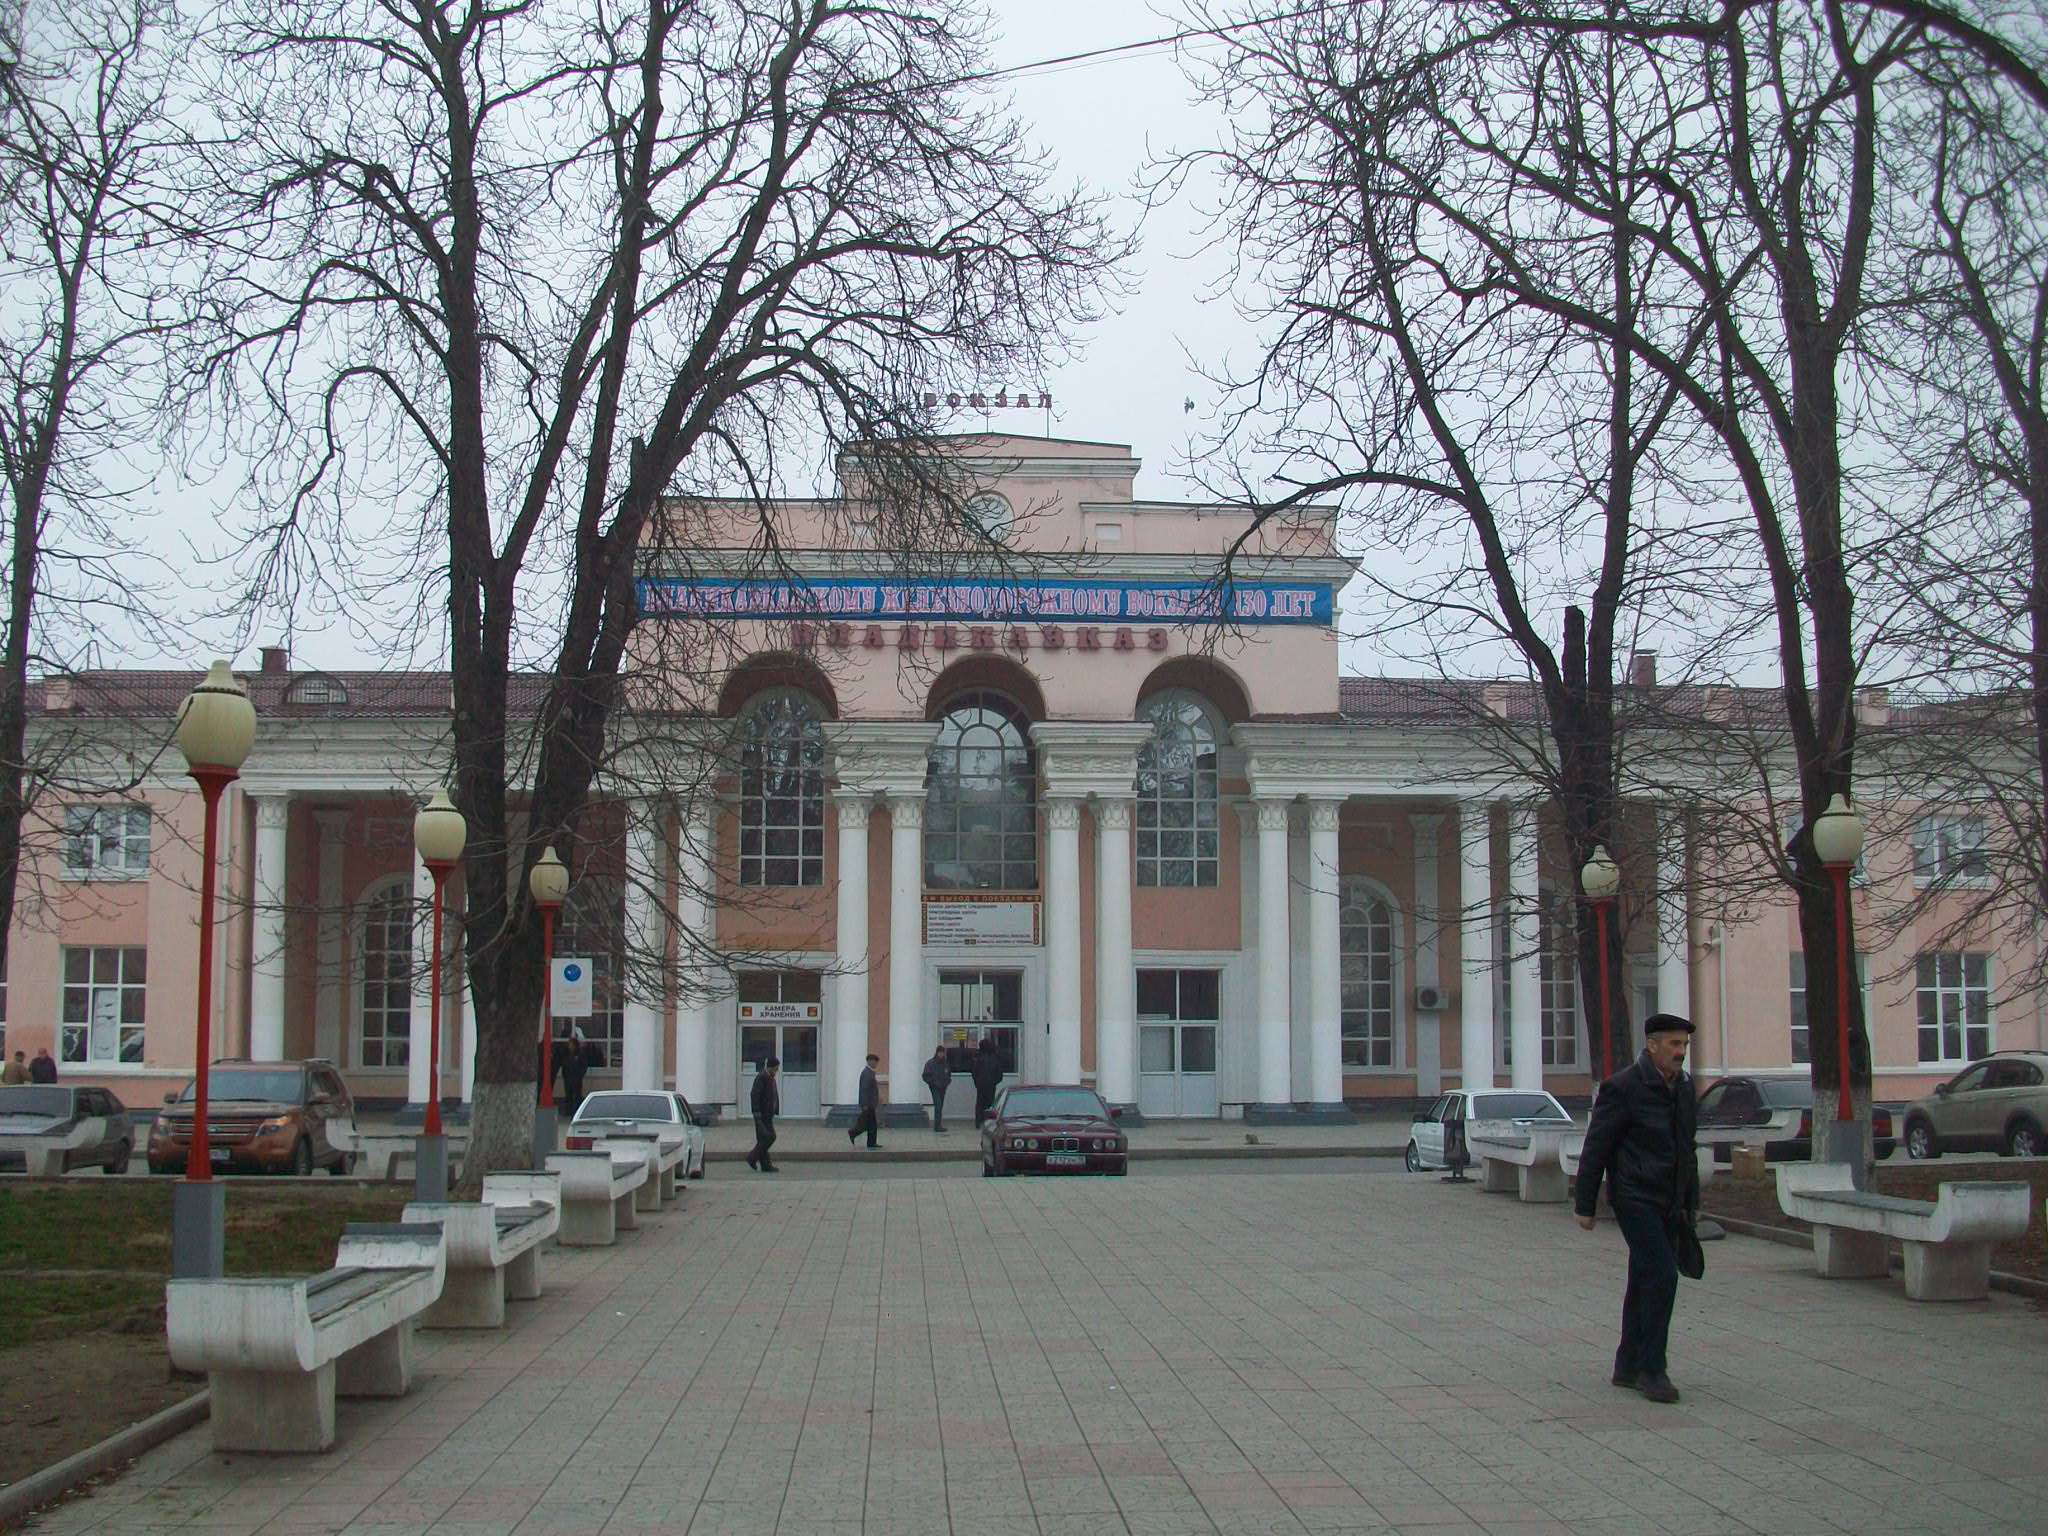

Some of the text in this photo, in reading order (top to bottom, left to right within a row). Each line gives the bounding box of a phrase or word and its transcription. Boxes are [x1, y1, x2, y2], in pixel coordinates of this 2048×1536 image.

[923, 393, 1053, 409] ВОКЗАЛ
[880, 586, 1120, 620] ЖЕЛЕЗНОДОРОЖНОМУ
[1234, 590, 1267, 617] 130
[1270, 590, 1316, 617] ЛЕТ
[791, 622, 1169, 651] ВЛАДИКАВКАЗ
